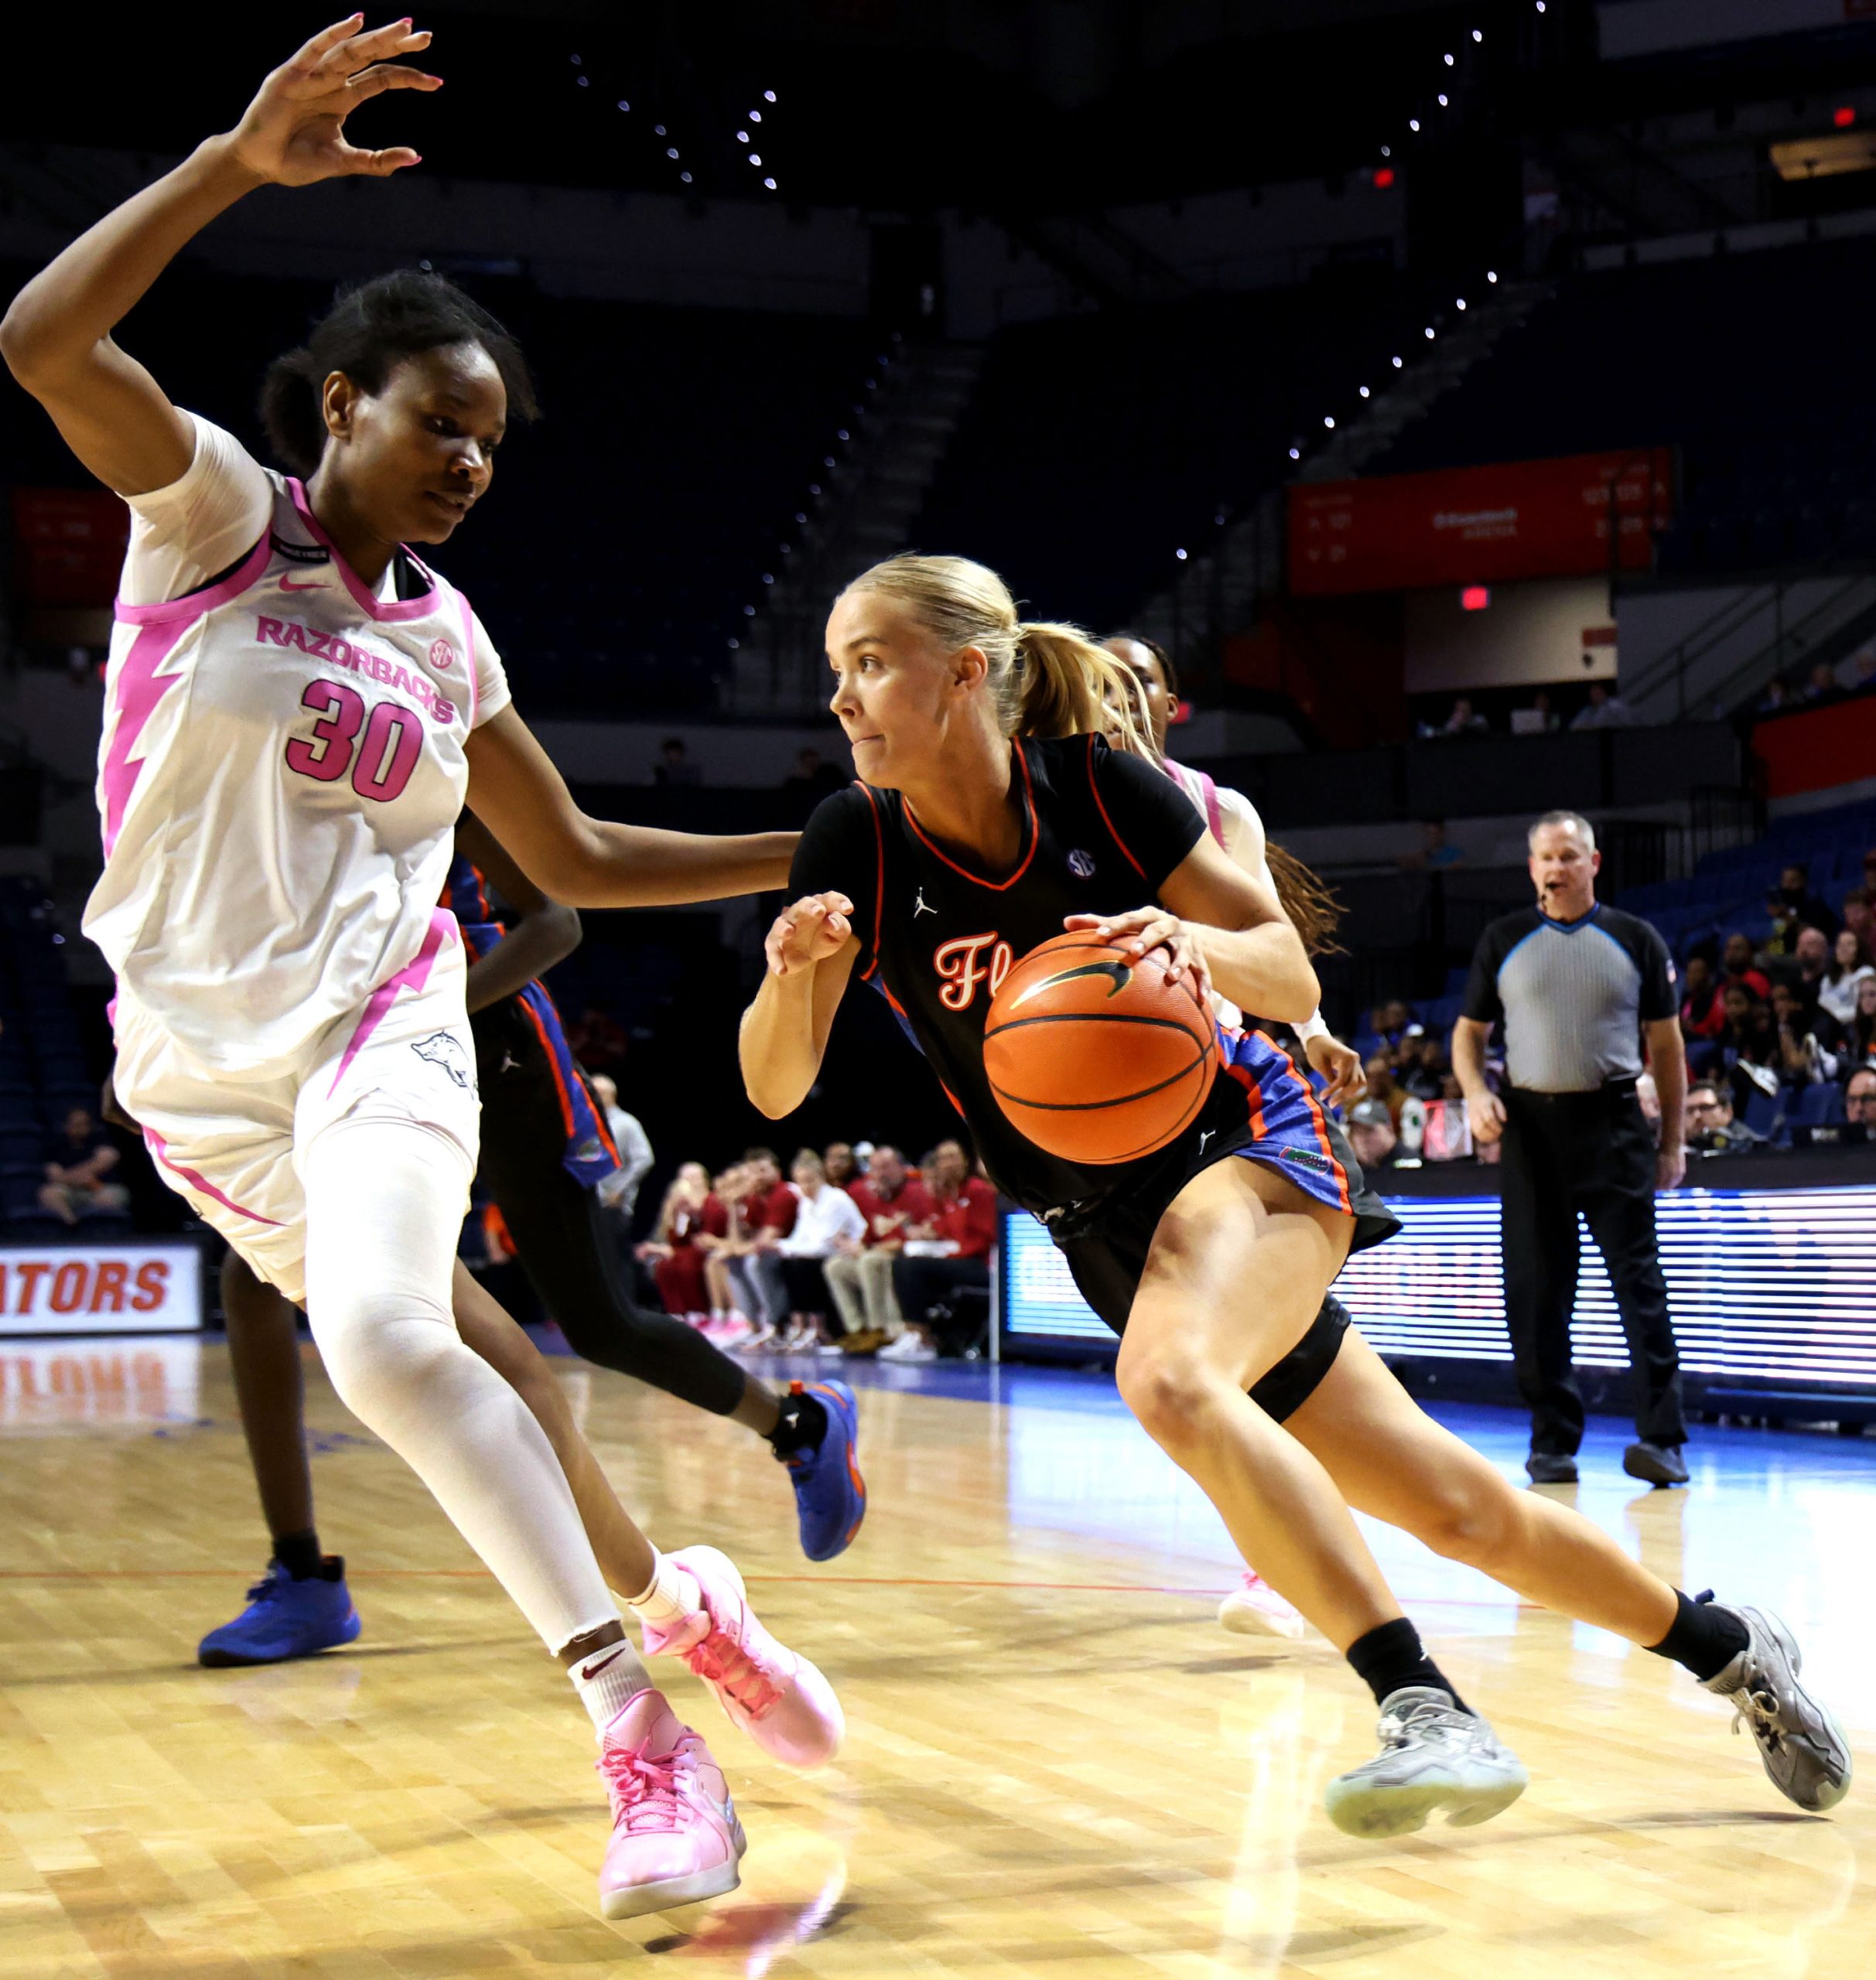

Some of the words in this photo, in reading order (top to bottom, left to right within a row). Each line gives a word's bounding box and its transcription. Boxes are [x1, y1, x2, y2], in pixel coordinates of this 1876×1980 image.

[256, 616, 454, 724] RAZORBACKS
[285, 679, 424, 802] 30
[1068, 848, 1096, 877] SEC
[934, 930, 1013, 1011] Fl
[0, 1261, 169, 1313] TORS
